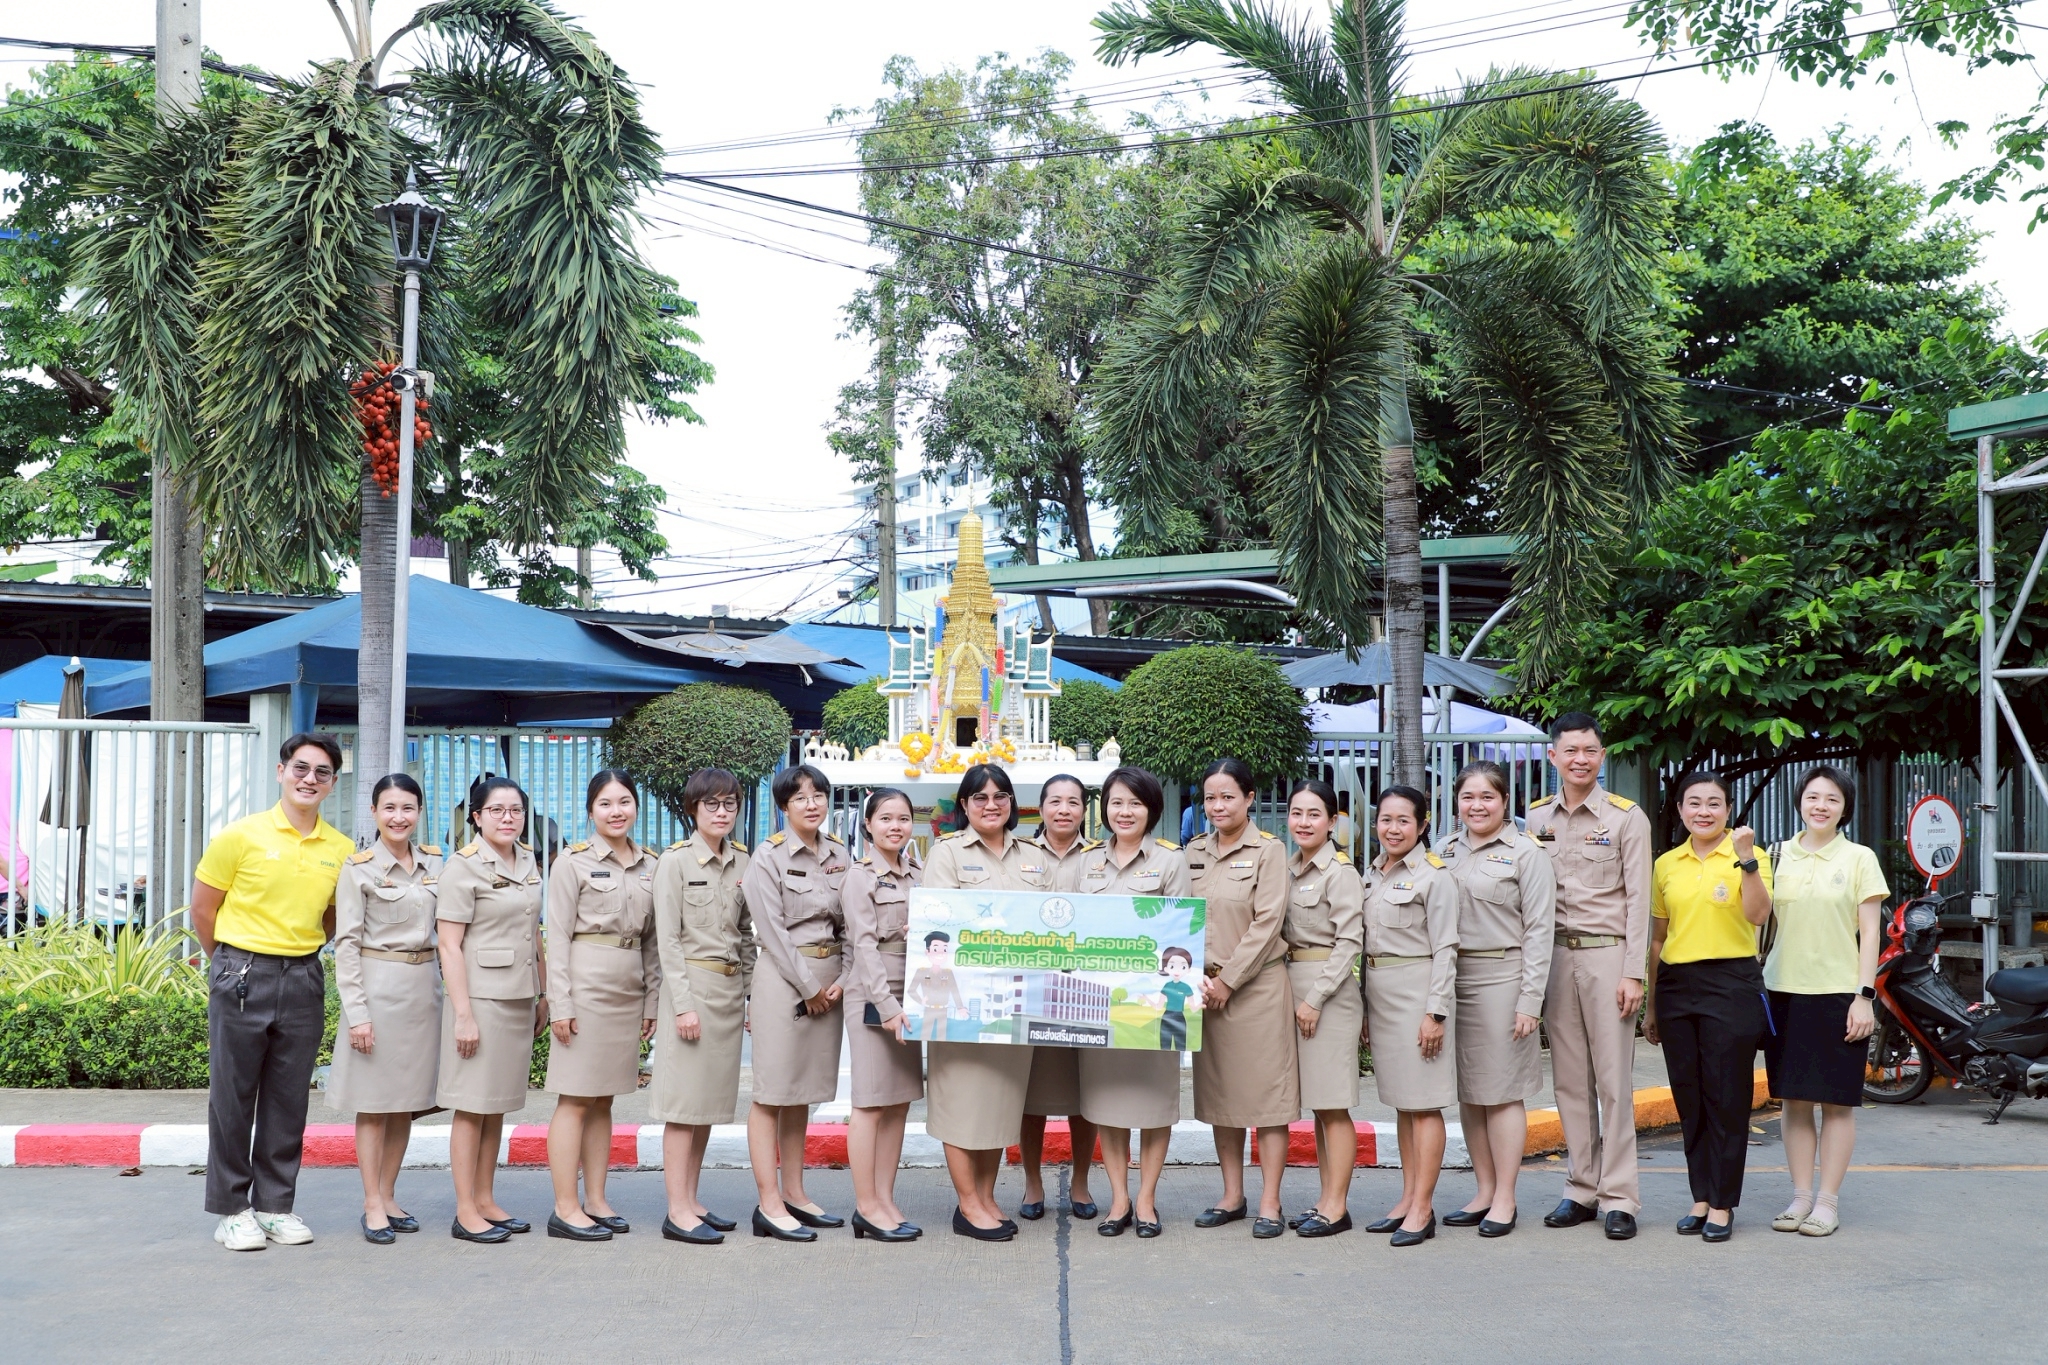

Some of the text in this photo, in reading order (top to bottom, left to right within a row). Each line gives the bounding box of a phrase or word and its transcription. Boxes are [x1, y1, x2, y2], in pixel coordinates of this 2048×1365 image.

[956, 947, 1158, 972] กรมส่งเสริมการเกษตร
[1030, 1028, 1106, 1044] กรมส่งเสริมการเกษตร
